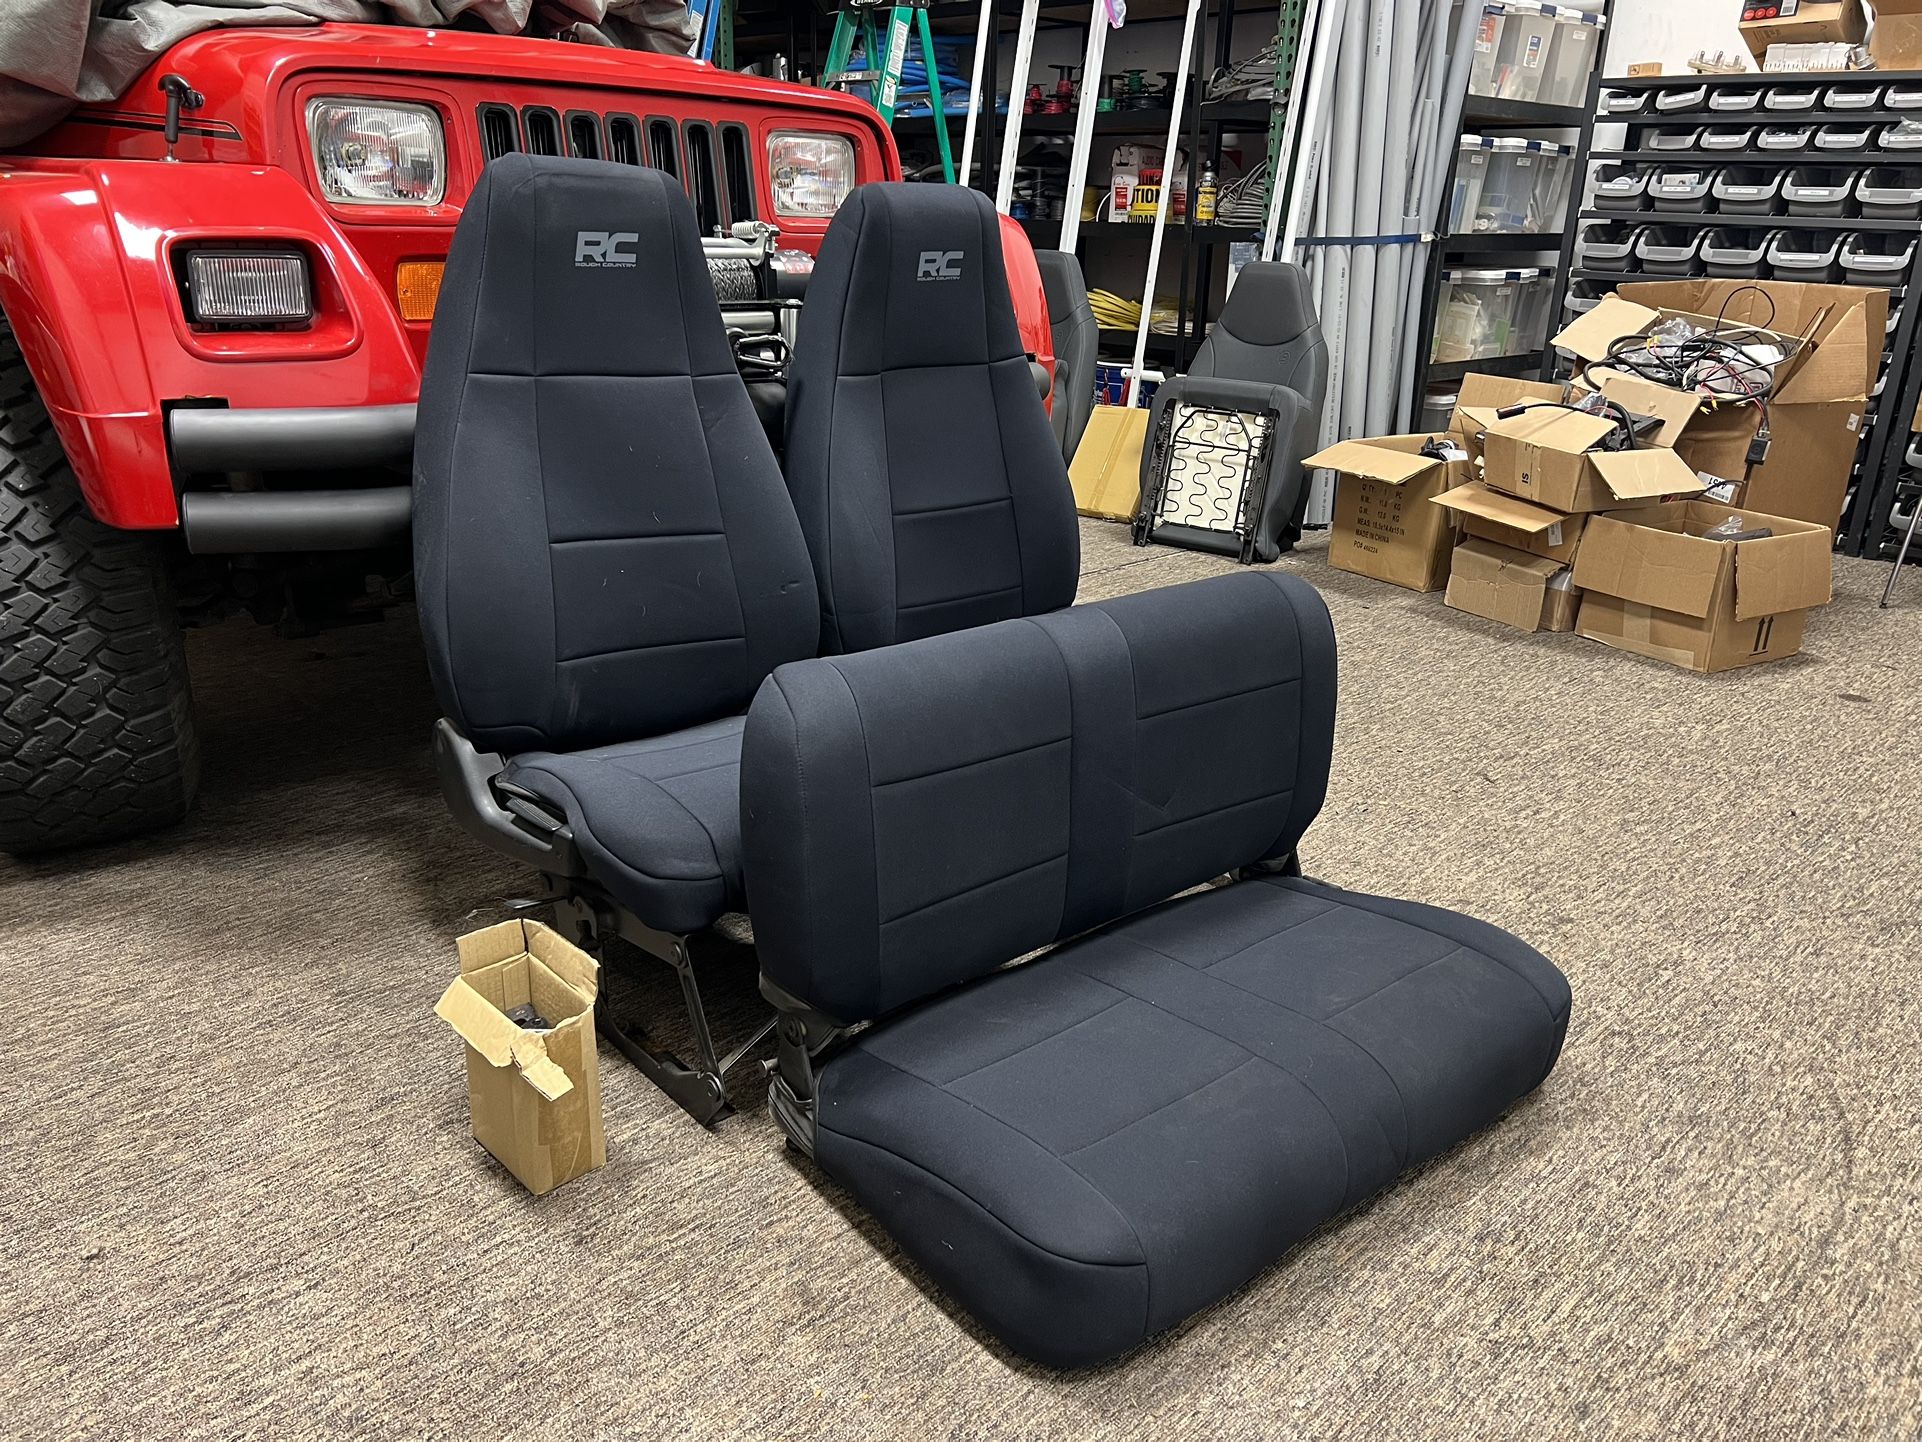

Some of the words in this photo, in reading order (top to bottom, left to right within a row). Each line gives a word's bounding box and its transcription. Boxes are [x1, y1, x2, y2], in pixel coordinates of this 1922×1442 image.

[575, 231, 639, 262] RC
[917, 251, 964, 277] RC
[1392, 515, 1400, 523] KG
[1355, 528, 1369, 539] MADE
[1375, 534, 1390, 544] CHINA
